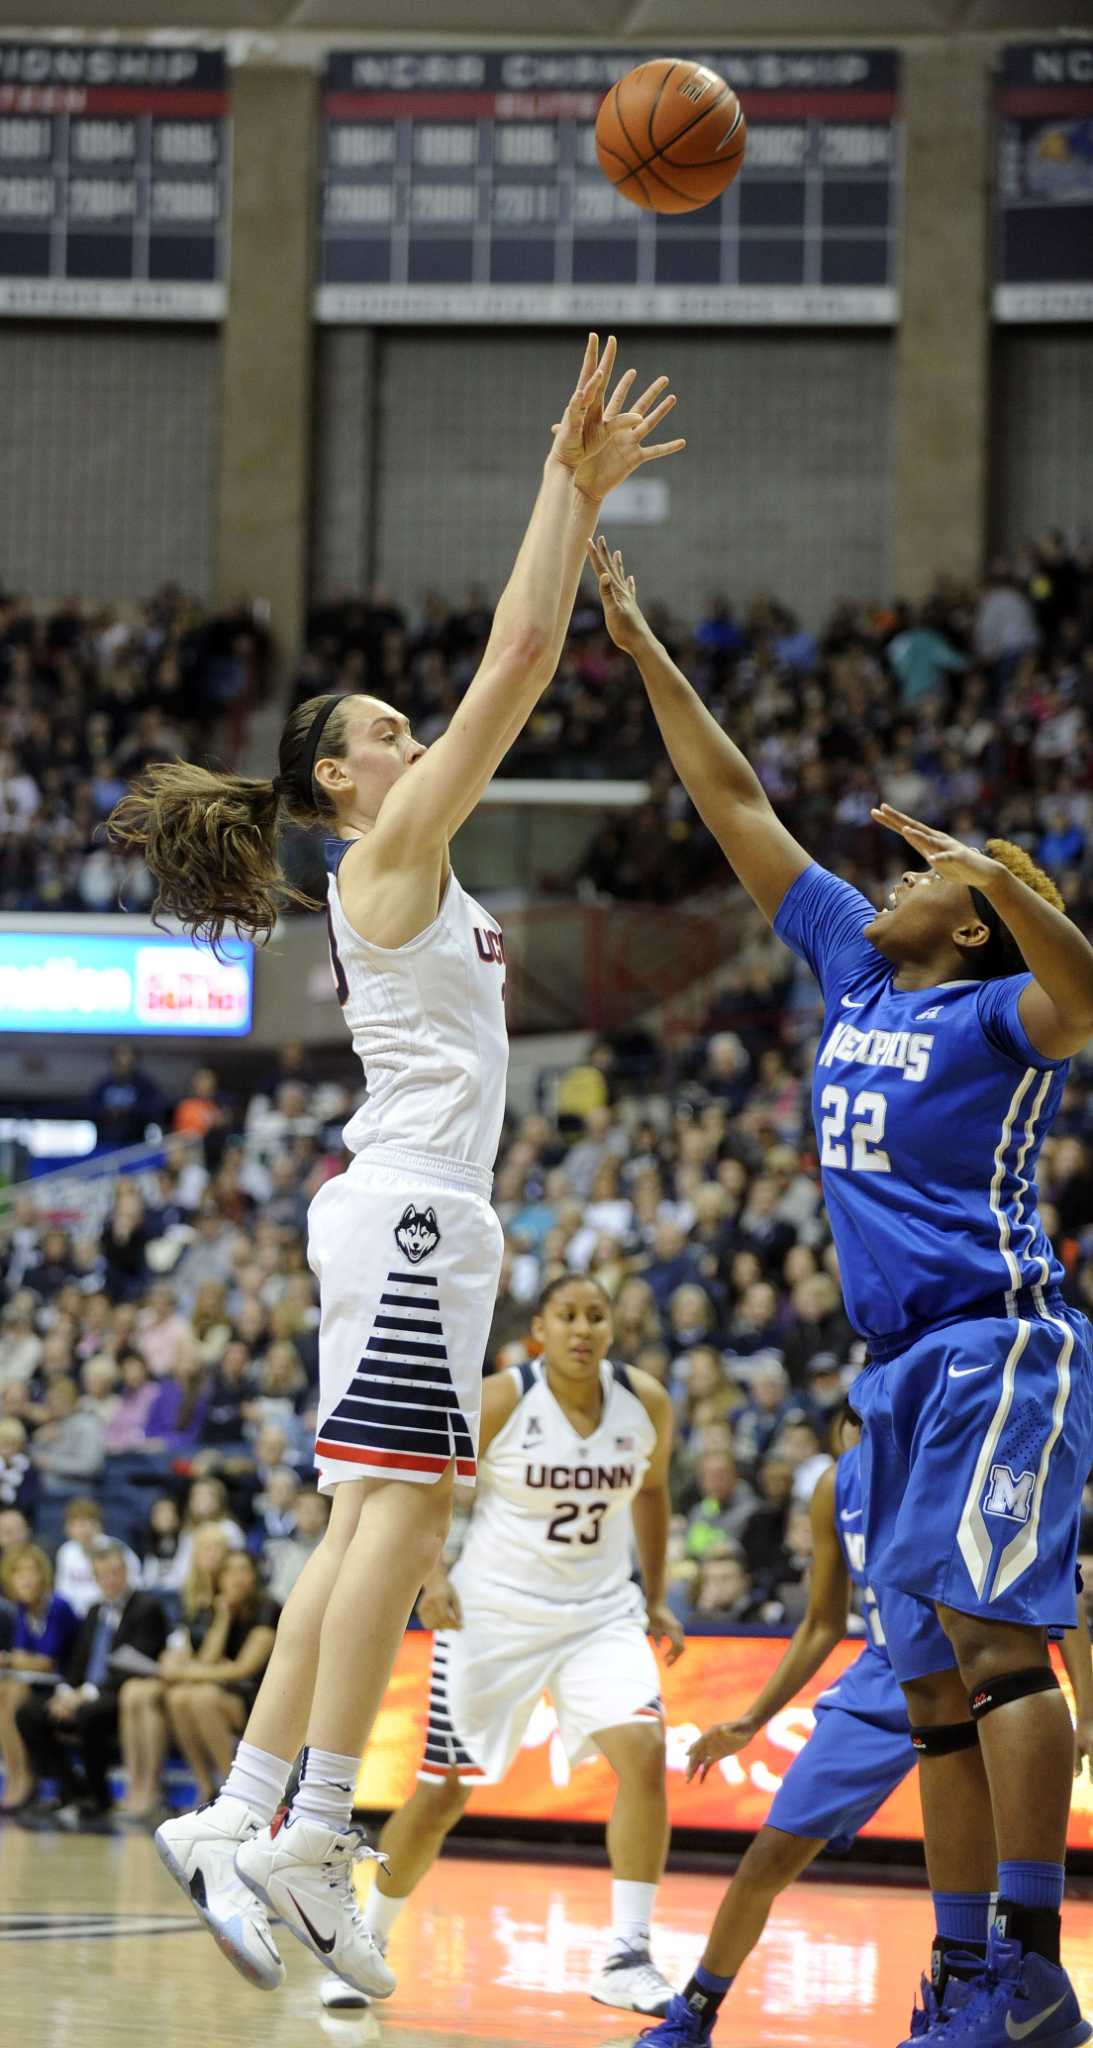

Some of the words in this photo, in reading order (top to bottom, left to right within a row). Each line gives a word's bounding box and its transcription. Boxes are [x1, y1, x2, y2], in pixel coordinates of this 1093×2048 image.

[820, 1084, 891, 1172] 22
[526, 1464, 634, 1490] UCONN
[547, 1502, 608, 1545] 23
